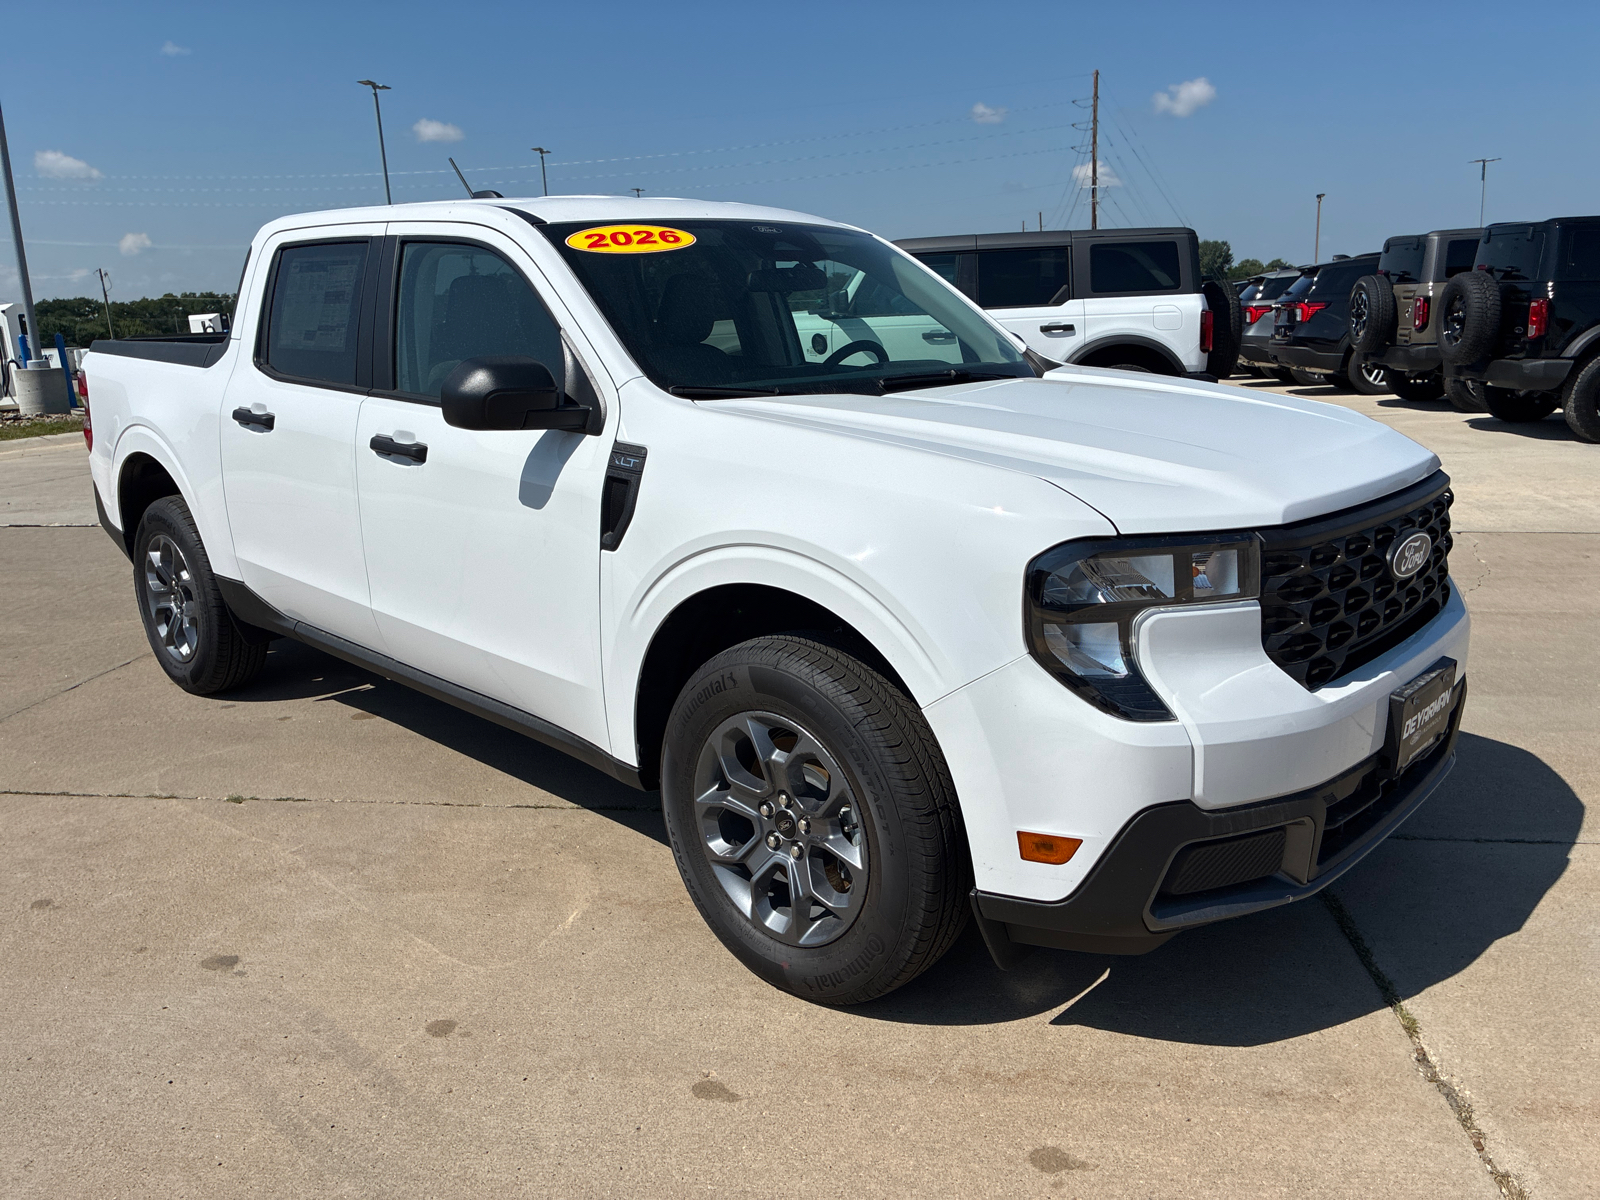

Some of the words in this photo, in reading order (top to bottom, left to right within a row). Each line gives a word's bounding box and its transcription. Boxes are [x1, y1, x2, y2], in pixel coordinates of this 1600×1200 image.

[584, 230, 682, 249] 2026
[611, 454, 639, 468] XLT
[1401, 540, 1426, 572] Ford
[673, 674, 728, 741] Continental
[1403, 688, 1452, 740] DEYARMAN
[814, 932, 886, 991] Continental
